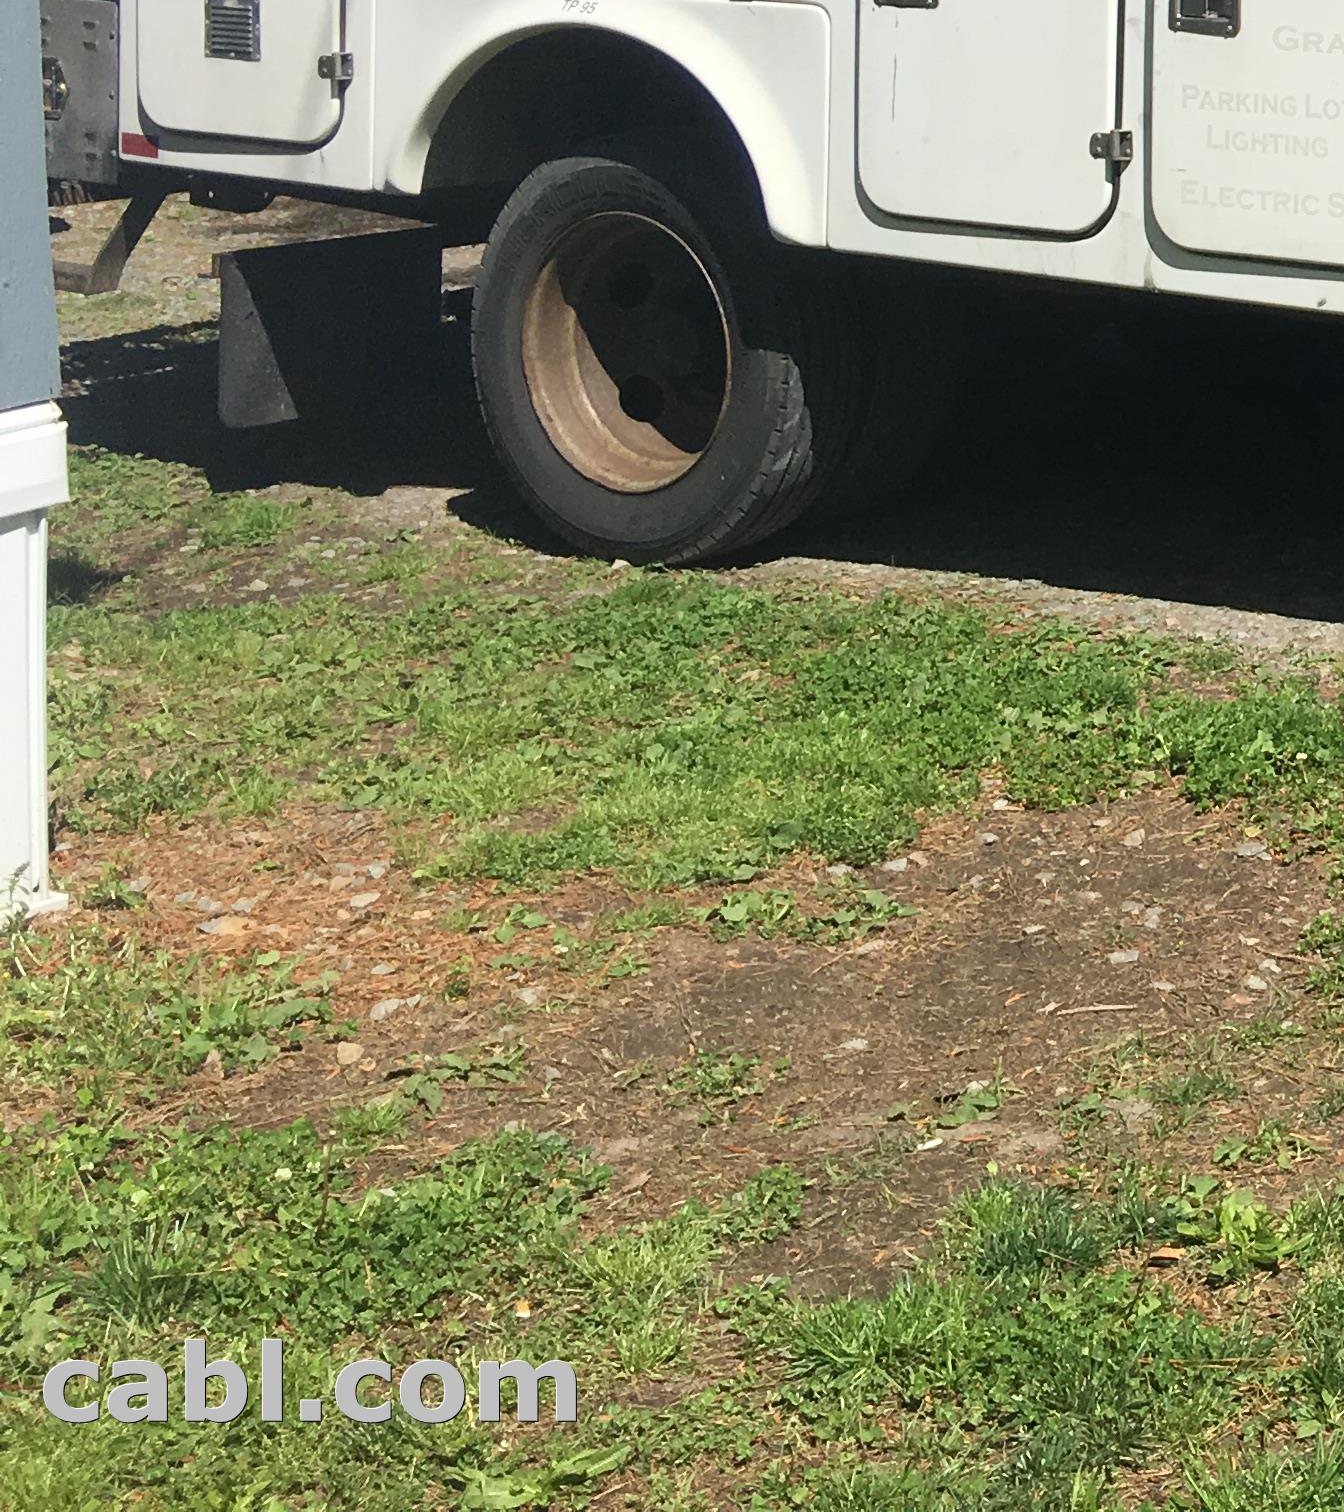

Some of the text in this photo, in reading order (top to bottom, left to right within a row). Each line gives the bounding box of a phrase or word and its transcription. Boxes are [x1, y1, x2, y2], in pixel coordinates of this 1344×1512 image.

[561, 0, 598, 14] TP 95
[1181, 84, 1298, 118] PARKING
[1205, 124, 1330, 159] LIGHTING
[1180, 179, 1320, 216] ELECTRIC
